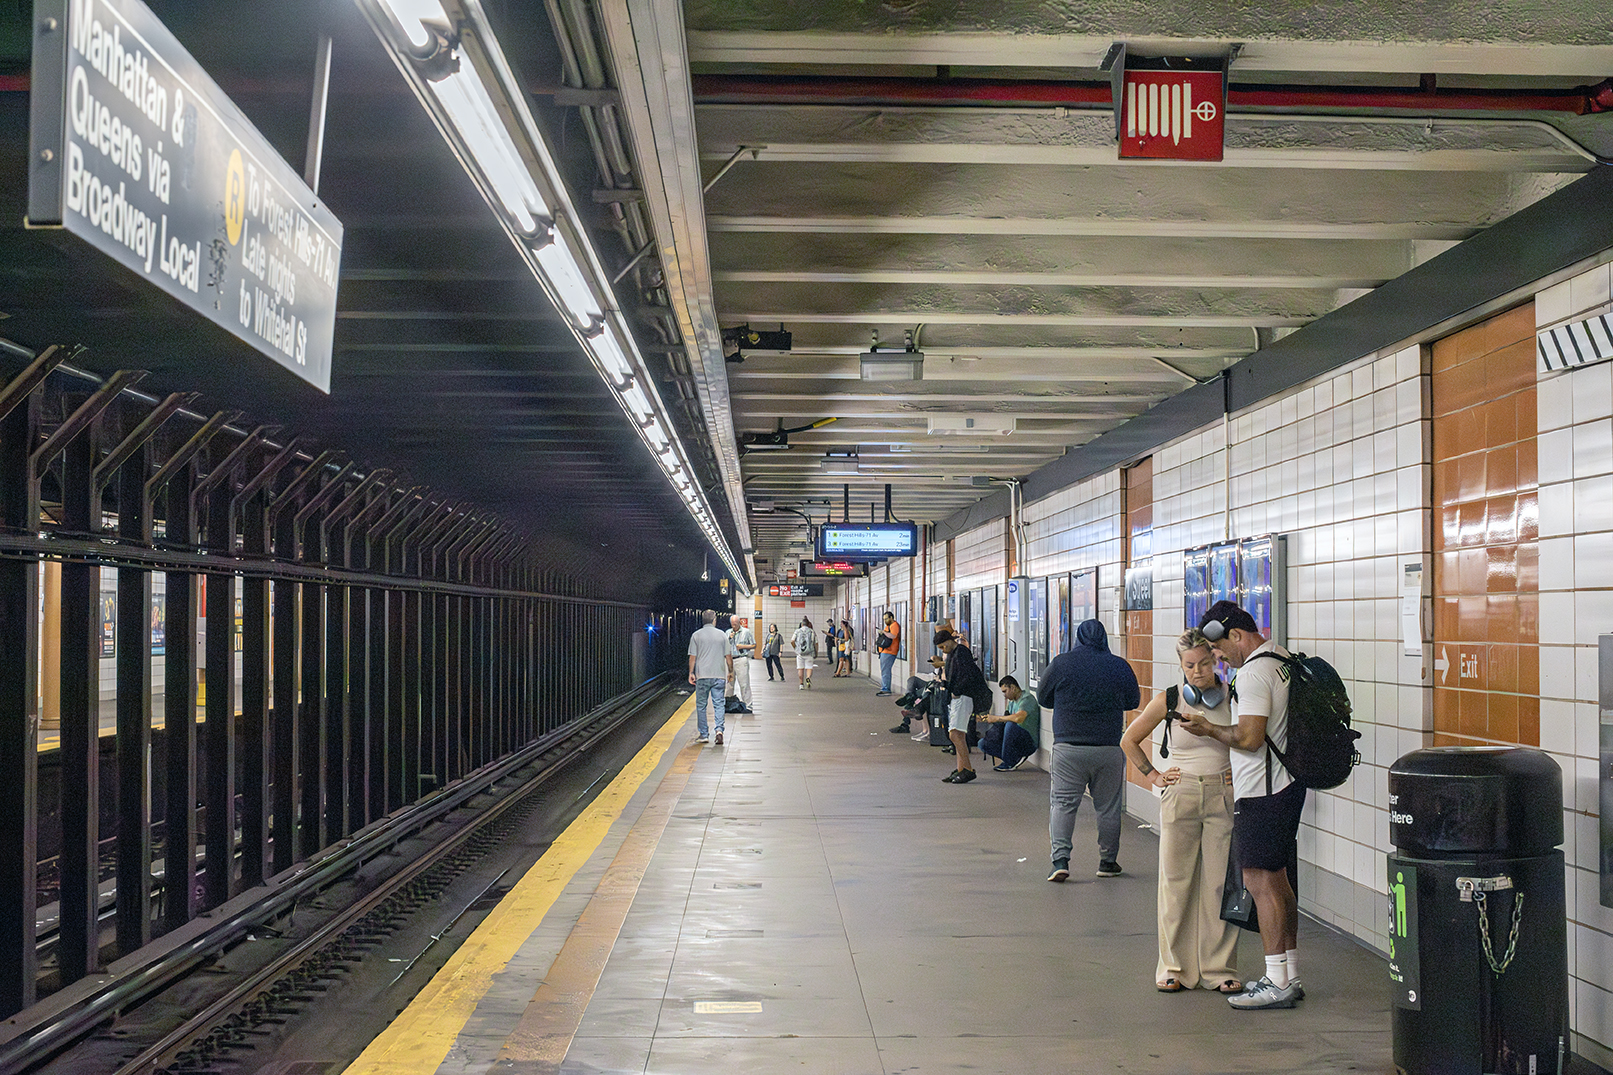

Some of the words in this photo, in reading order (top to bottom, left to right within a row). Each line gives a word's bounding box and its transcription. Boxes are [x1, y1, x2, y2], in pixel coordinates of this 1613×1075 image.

[72, 0, 167, 131] Manhattan
[172, 89, 184, 148] &
[70, 65, 143, 182] Queens
[148, 141, 171, 205] via
[67, 140, 157, 274] Broadway
[160, 214, 202, 293] Local
[248, 162, 260, 217] To
[262, 180, 294, 249] Forest
[242, 218, 266, 282] Late
[268, 250, 296, 306] nights
[239, 278, 252, 328] to
[255, 285, 296, 358] Whitehall
[296, 320, 308, 367] St
[701, 570, 708, 581] 4
[721, 587, 727, 595] 6
[1460, 653, 1478, 679] Exit
[1391, 810, 1414, 825] Here
